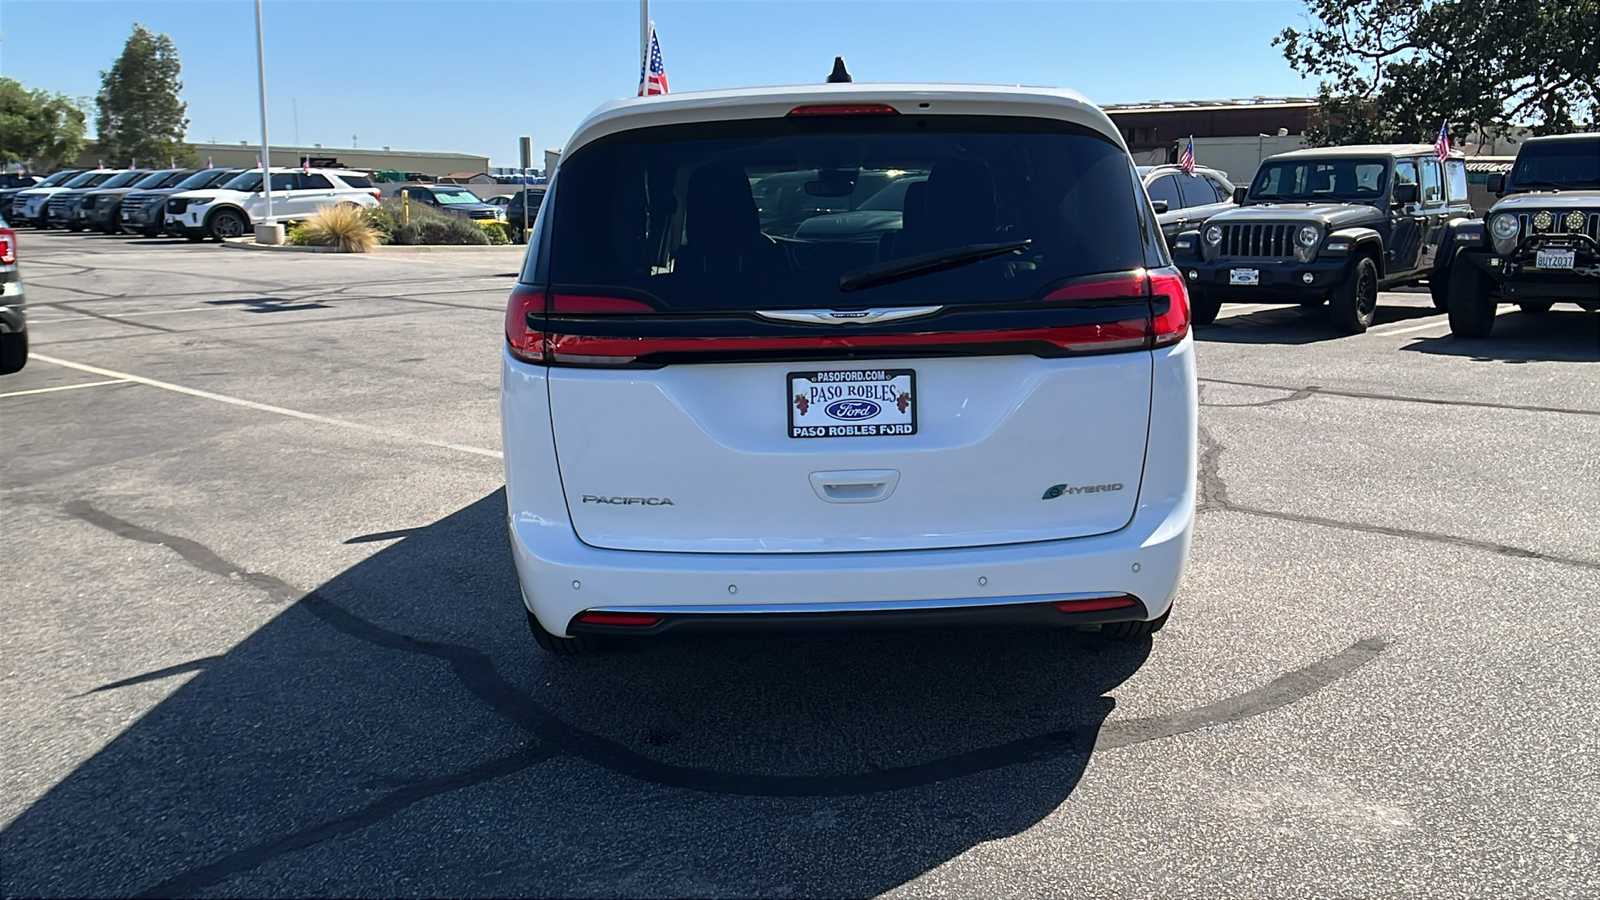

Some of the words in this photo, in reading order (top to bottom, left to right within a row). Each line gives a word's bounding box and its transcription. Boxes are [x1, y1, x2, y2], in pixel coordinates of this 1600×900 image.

[1537, 256, 1573, 267] 8UYZ037
[817, 371, 885, 382] PASOFORD.COM
[810, 386, 843, 404] PASO
[847, 385, 897, 402] ROBLES
[836, 402, 871, 417] Ford
[793, 427, 825, 436] PASO
[829, 426, 876, 435] ROBLES
[880, 425, 913, 434] FORD
[582, 494, 675, 506] PACIFICA
